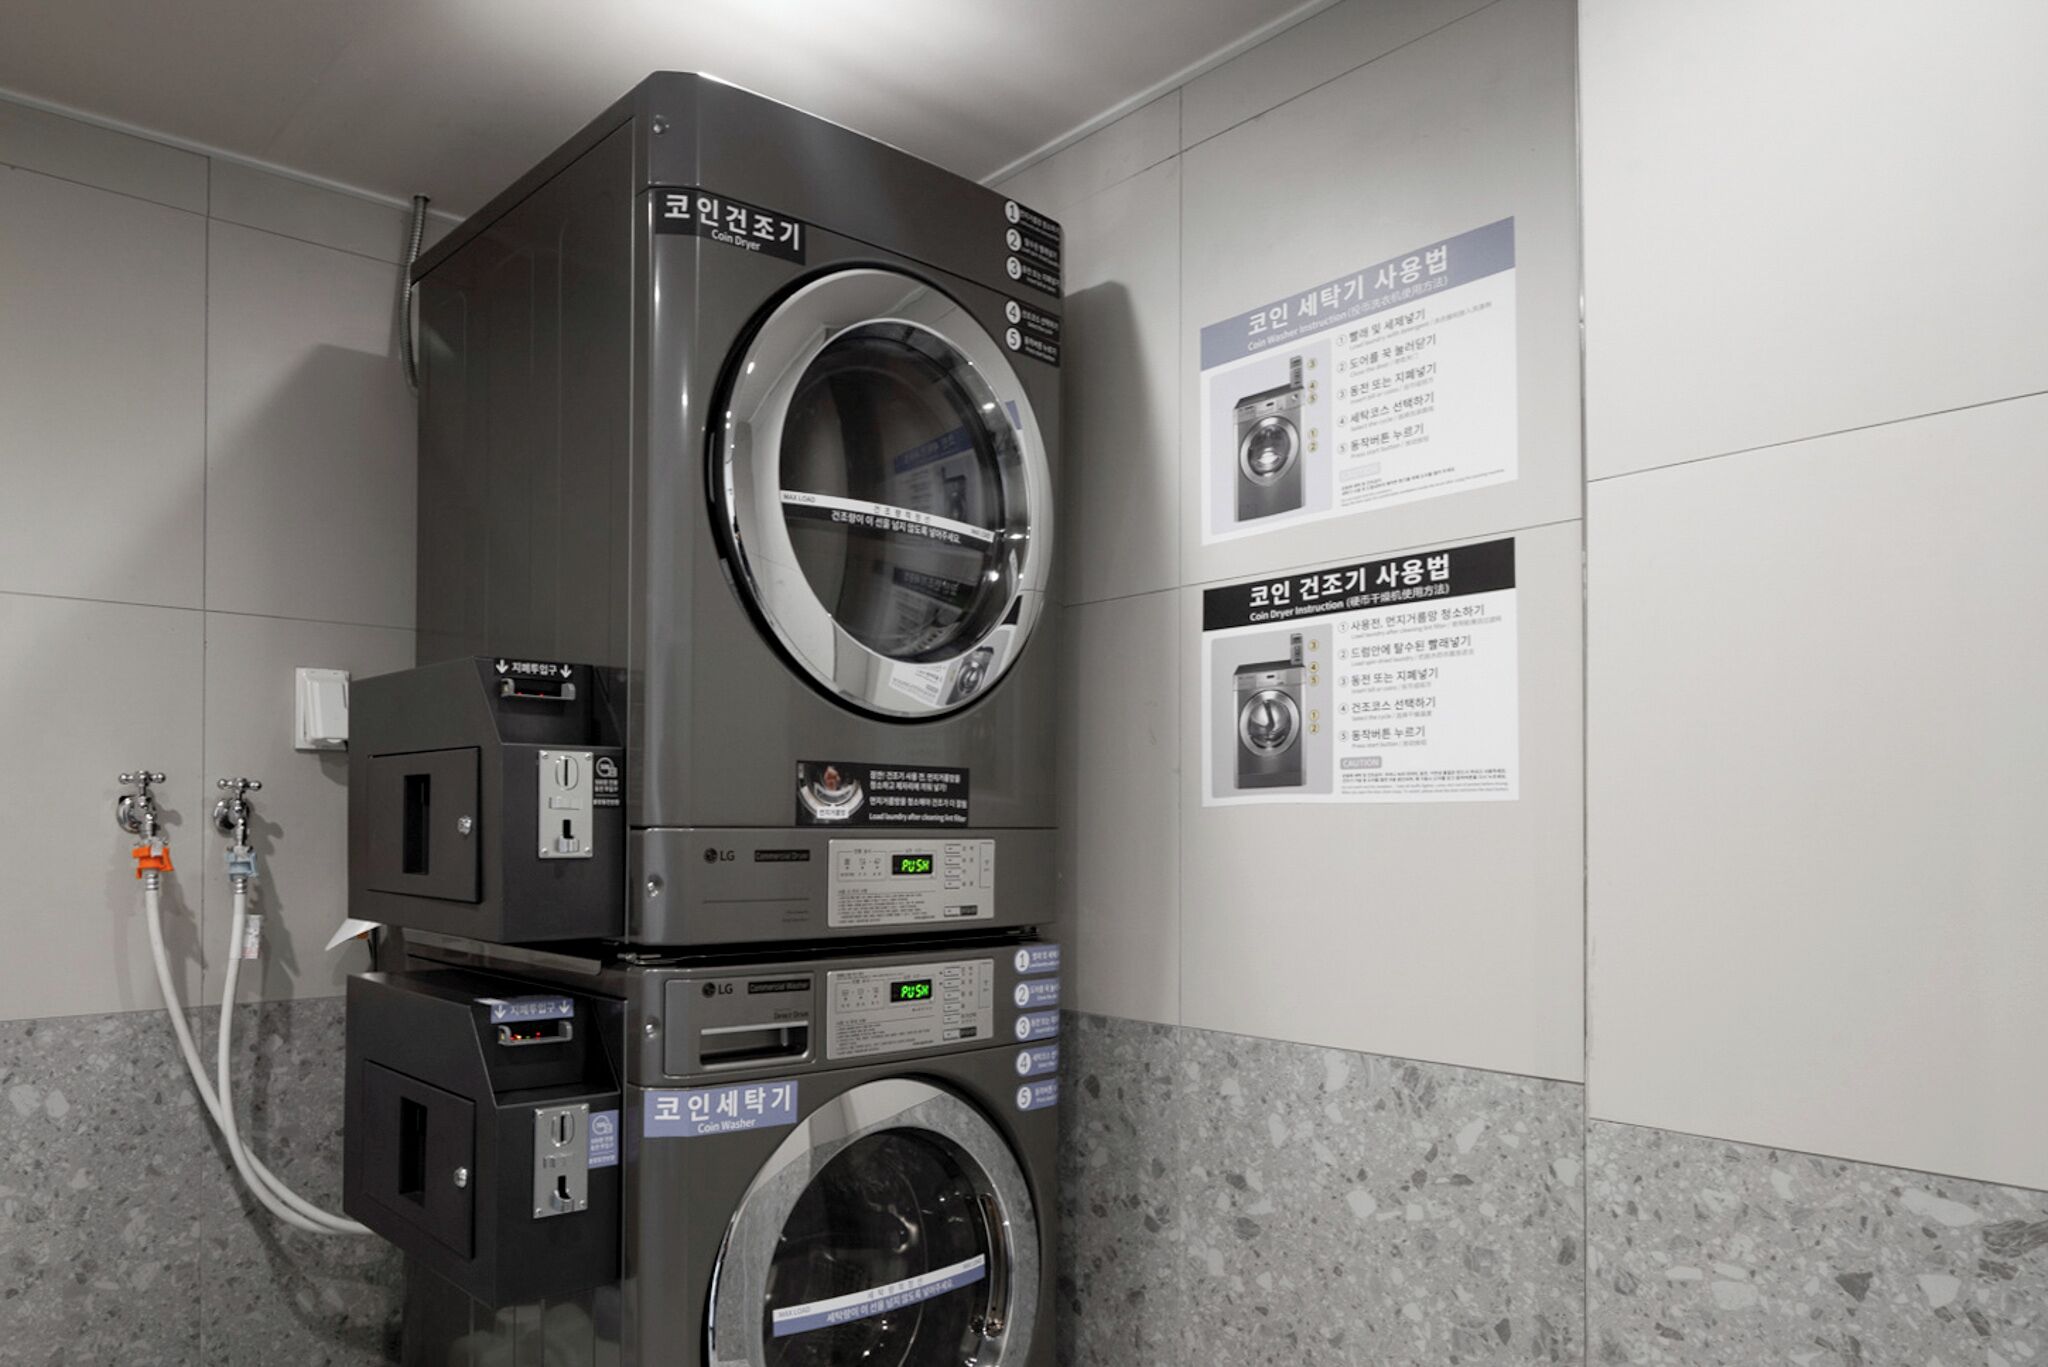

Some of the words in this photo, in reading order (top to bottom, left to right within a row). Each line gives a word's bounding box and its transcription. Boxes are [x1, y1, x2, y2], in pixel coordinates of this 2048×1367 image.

[664, 194, 800, 251] 코인건조기
[711, 230, 734, 244] Coin
[734, 237, 762, 252] Dryer
[1248, 303, 1289, 336] 코인
[1298, 275, 1364, 317] 세탁기
[1374, 244, 1448, 290] 사용법
[1247, 340, 1267, 352] Coin
[1268, 328, 1300, 347] Washer
[1300, 312, 1348, 335] Instruction
[1349, 326, 1369, 342] 빨래
[1371, 322, 1382, 335] 및
[1349, 351, 1378, 370] 도어를
[1350, 382, 1369, 398] 동전
[1372, 377, 1392, 391] 또는
[1395, 361, 1437, 384] 지폐넣기
[1350, 406, 1391, 423] 세탁코스
[1393, 391, 1435, 413] 선택하기
[1350, 431, 1390, 451] 동작버튼
[1393, 422, 1424, 440] 누르기
[831, 510, 864, 526] 건조량이
[865, 514, 875, 527] 이
[1250, 580, 1291, 608] 코인
[1299, 567, 1366, 602] 건조기
[1376, 553, 1450, 588] 사용법
[1250, 611, 1270, 622] Coin
[1270, 606, 1295, 620] Dryer
[1295, 599, 1345, 616] Instruction
[1386, 610, 1438, 629] 먼지거름망
[1440, 604, 1486, 623] 청소하기
[1350, 642, 1392, 659] 드럼안에
[1393, 639, 1426, 656] 탈수된
[1427, 634, 1472, 651] 빨래넣기
[511, 661, 558, 676] 지폐투입구
[1351, 673, 1371, 687] 동전
[1373, 671, 1393, 684] 또는
[1396, 667, 1439, 682] 지폐넣기
[1352, 700, 1392, 713] 건조코스
[1394, 696, 1436, 712] 선택하기
[1352, 727, 1391, 741] 동작버튼
[1394, 724, 1426, 739] 누르기
[719, 849, 736, 862] LG
[901, 858, 931, 874] PUSH
[718, 983, 734, 995] LG
[900, 983, 930, 999] PUSH
[654, 1084, 791, 1122] 코인세탁기
[697, 1122, 720, 1134] Coin
[721, 1118, 757, 1131] Washer
